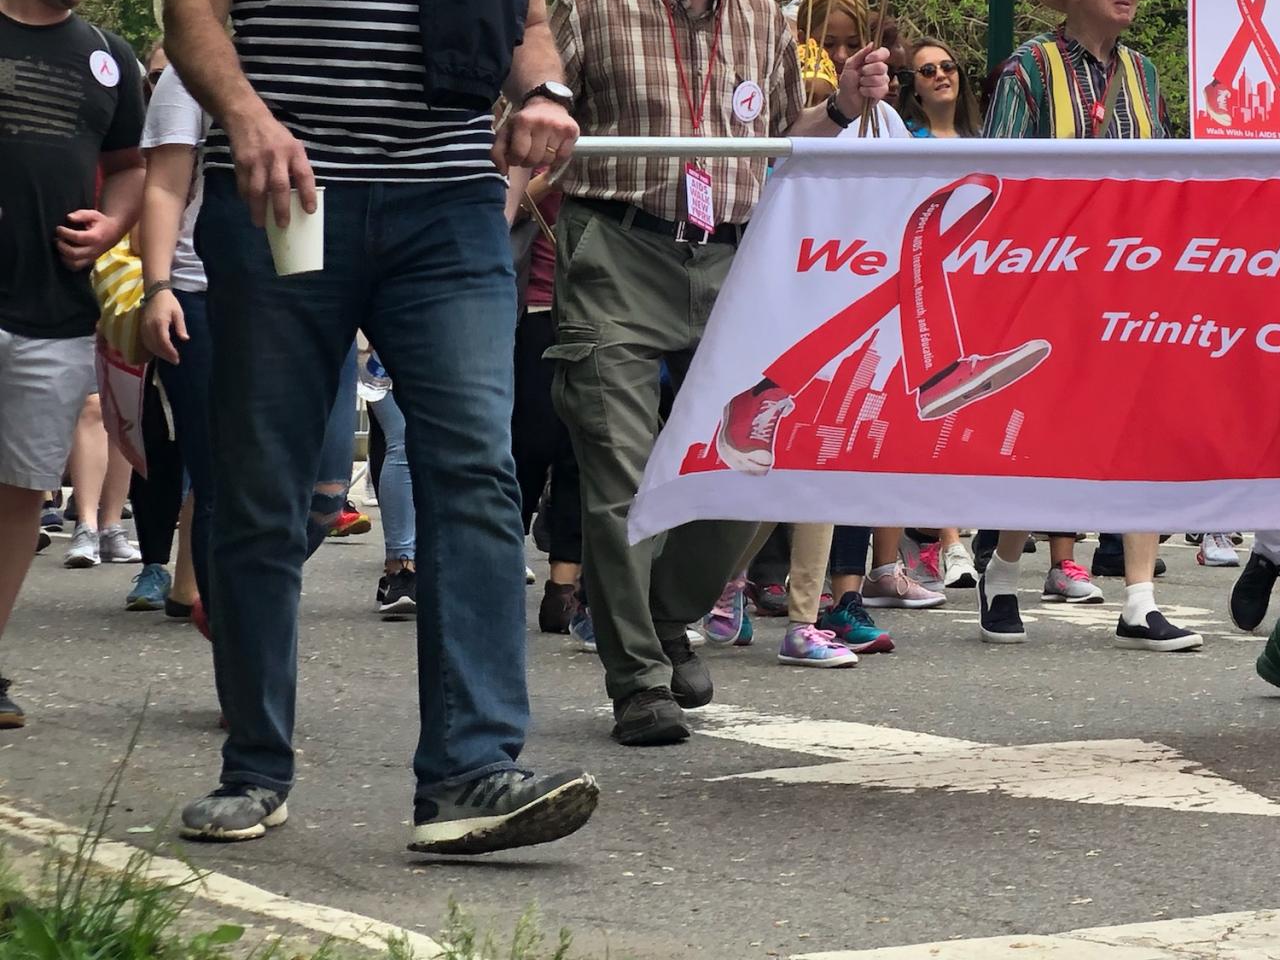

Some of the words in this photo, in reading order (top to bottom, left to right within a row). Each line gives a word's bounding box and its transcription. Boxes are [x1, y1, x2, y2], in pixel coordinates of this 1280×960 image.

[1206, 127, 1224, 135] Walk
[1226, 128, 1244, 136] With
[1259, 131, 1277, 139] AIDS
[916, 202, 939, 233] Support
[912, 235, 923, 252] AIDS
[796, 238, 888, 276] We
[948, 236, 1090, 276] Walk
[1104, 238, 1164, 272] To
[918, 319, 929, 332] and
[1099, 310, 1244, 358] Trinity
